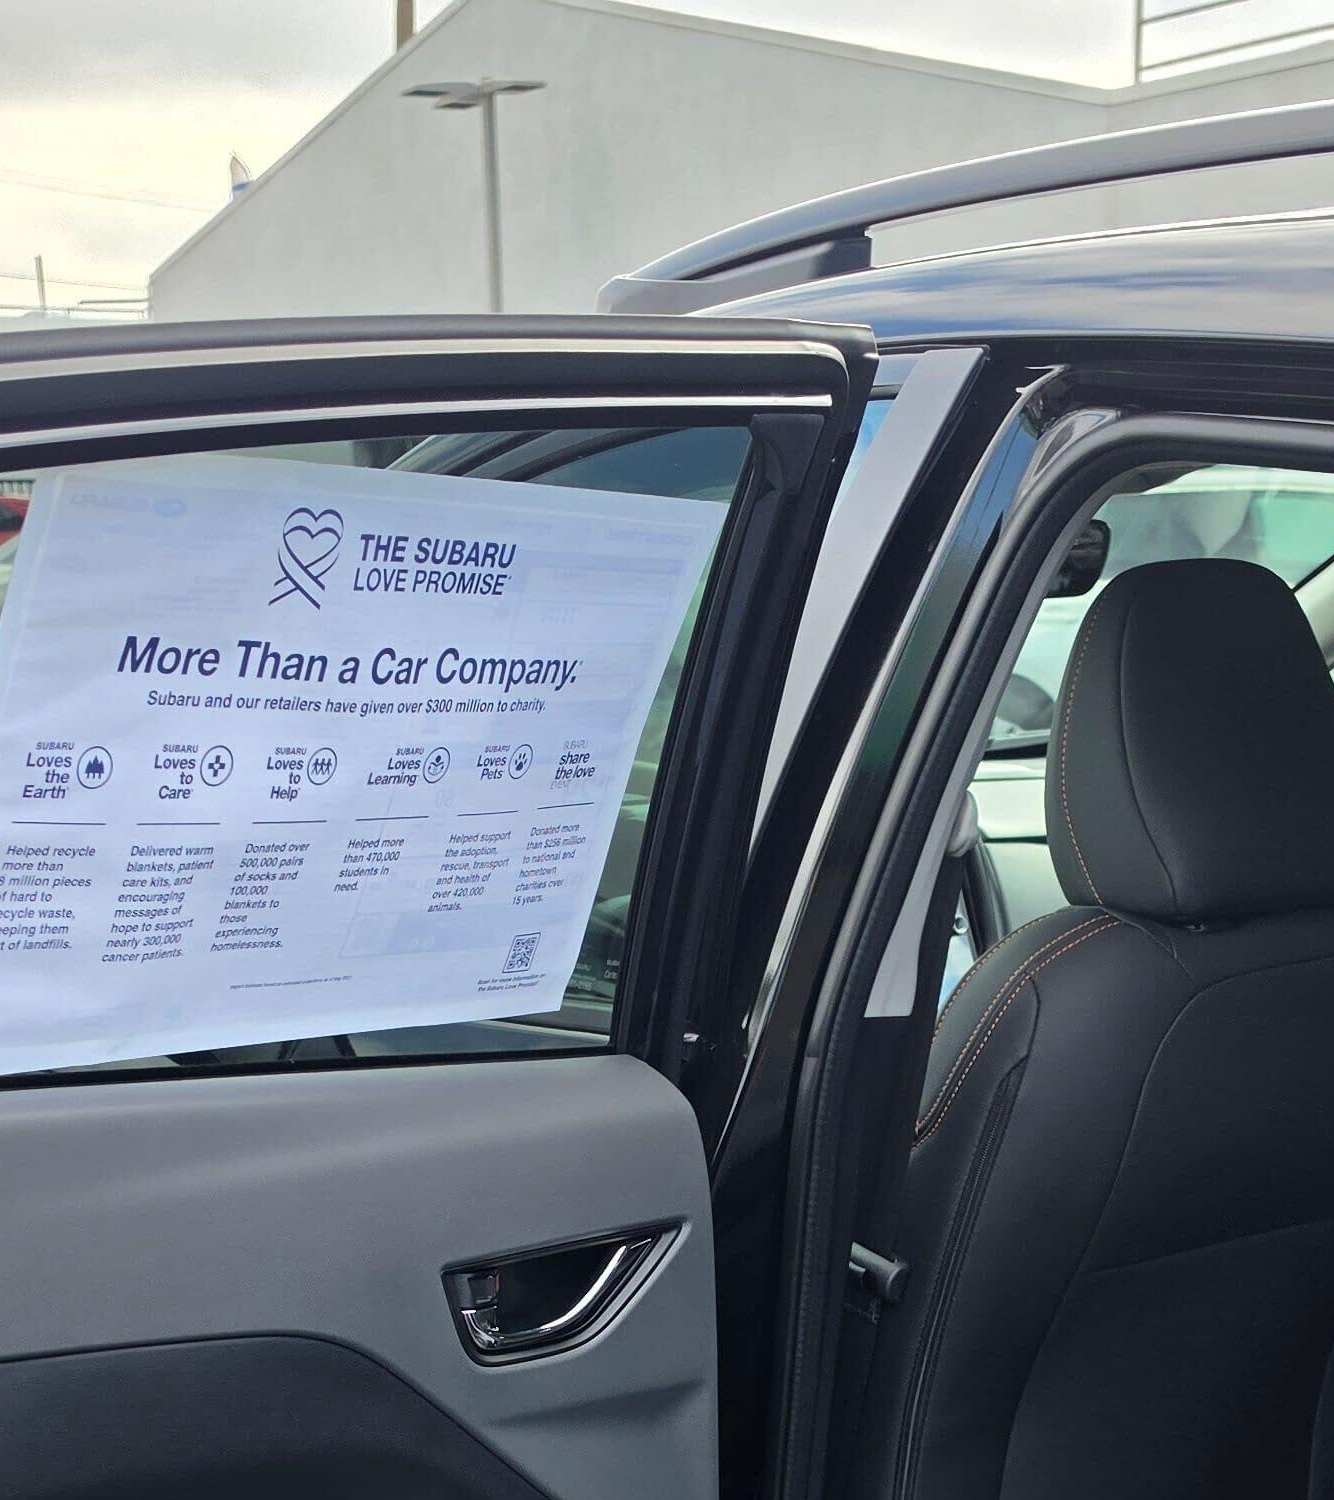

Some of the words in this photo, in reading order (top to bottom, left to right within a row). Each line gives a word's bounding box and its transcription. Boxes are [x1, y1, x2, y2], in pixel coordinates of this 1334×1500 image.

[360, 534, 409, 562] THE
[414, 537, 516, 568] SUBARU
[353, 567, 408, 592] LOVE
[116, 635, 220, 676] More
[235, 639, 328, 682] Than
[338, 656, 359, 685] a
[371, 647, 427, 686] Car
[148, 690, 200, 708] Subaru
[205, 693, 231, 709] and
[237, 696, 260, 710] our
[264, 694, 321, 712] retailers
[325, 698, 356, 713] have
[359, 699, 393, 717] given
[397, 701, 423, 714] over
[425, 698, 452, 714] $300
[455, 698, 494, 713] million
[497, 699, 508, 712] to
[510, 698, 546, 715] charity.
[36, 742, 75, 750] SUBARU
[163, 744, 199, 753] SUBARU
[275, 747, 307, 756] SUBARU
[396, 748, 424, 756] SUBARU
[26, 752, 72, 767] Loves
[154, 754, 195, 769] Loves
[267, 756, 303, 770] Loves
[387, 758, 421, 770] Loves
[477, 755, 507, 768] Loves
[559, 751, 589, 766] share
[45, 768, 69, 784] the
[179, 772, 193, 784] to
[289, 772, 301, 784] to
[367, 772, 417, 786] Learning
[481, 768, 503, 780] Pets
[555, 766, 571, 780] the
[573, 766, 595, 778] love
[22, 784, 66, 798] Earth
[159, 786, 191, 799] Care
[270, 786, 298, 801] Help
[449, 834, 478, 845] Helped
[479, 831, 512, 842] support
[245, 843, 287, 853] Donated
[289, 844, 310, 852] over
[347, 839, 380, 851] Helped
[381, 838, 405, 848] more
[7, 846, 49, 858] Helped
[53, 846, 95, 858] recycle
[131, 846, 183, 856] Delivered
[185, 846, 213, 856] warm
[445, 848, 459, 857] the
[279, 856, 304, 868] pairs
[343, 854, 363, 864] than
[366, 851, 401, 863] 470,000
[2, 862, 33, 870] more
[37, 861, 63, 871] than
[127, 862, 176, 872] blankets,
[178, 860, 213, 872] patient
[339, 866, 379, 878] students
[380, 866, 389, 876] in
[8, 875, 49, 886] million
[53, 876, 91, 888] pieces
[123, 879, 147, 887] care
[150, 877, 171, 888] kits,
[174, 875, 193, 884] and
[235, 872, 247, 881] of
[247, 871, 277, 880] socks
[279, 870, 299, 880] and
[436, 876, 453, 886] and
[453, 874, 479, 884] health
[481, 872, 491, 882] of
[10, 891, 37, 902] hard
[41, 892, 53, 902] to
[231, 886, 269, 896] 100,000
[432, 890, 451, 898] over
[118, 891, 185, 904] encouraging
[225, 900, 267, 910] blankets
[269, 900, 279, 908] to
[38, 908, 75, 920] waste,
[114, 907, 169, 919] messages
[171, 904, 183, 914] of
[220, 914, 247, 924] those
[39, 924, 69, 934] them
[111, 923, 139, 934] hope
[141, 922, 152, 932] to
[155, 918, 194, 932] support
[215, 926, 279, 938] experiencing
[8, 940, 21, 950] of
[23, 939, 72, 950] landfills.
[107, 938, 141, 949] nearly
[143, 934, 181, 946] 300,000
[102, 953, 140, 962] cancer
